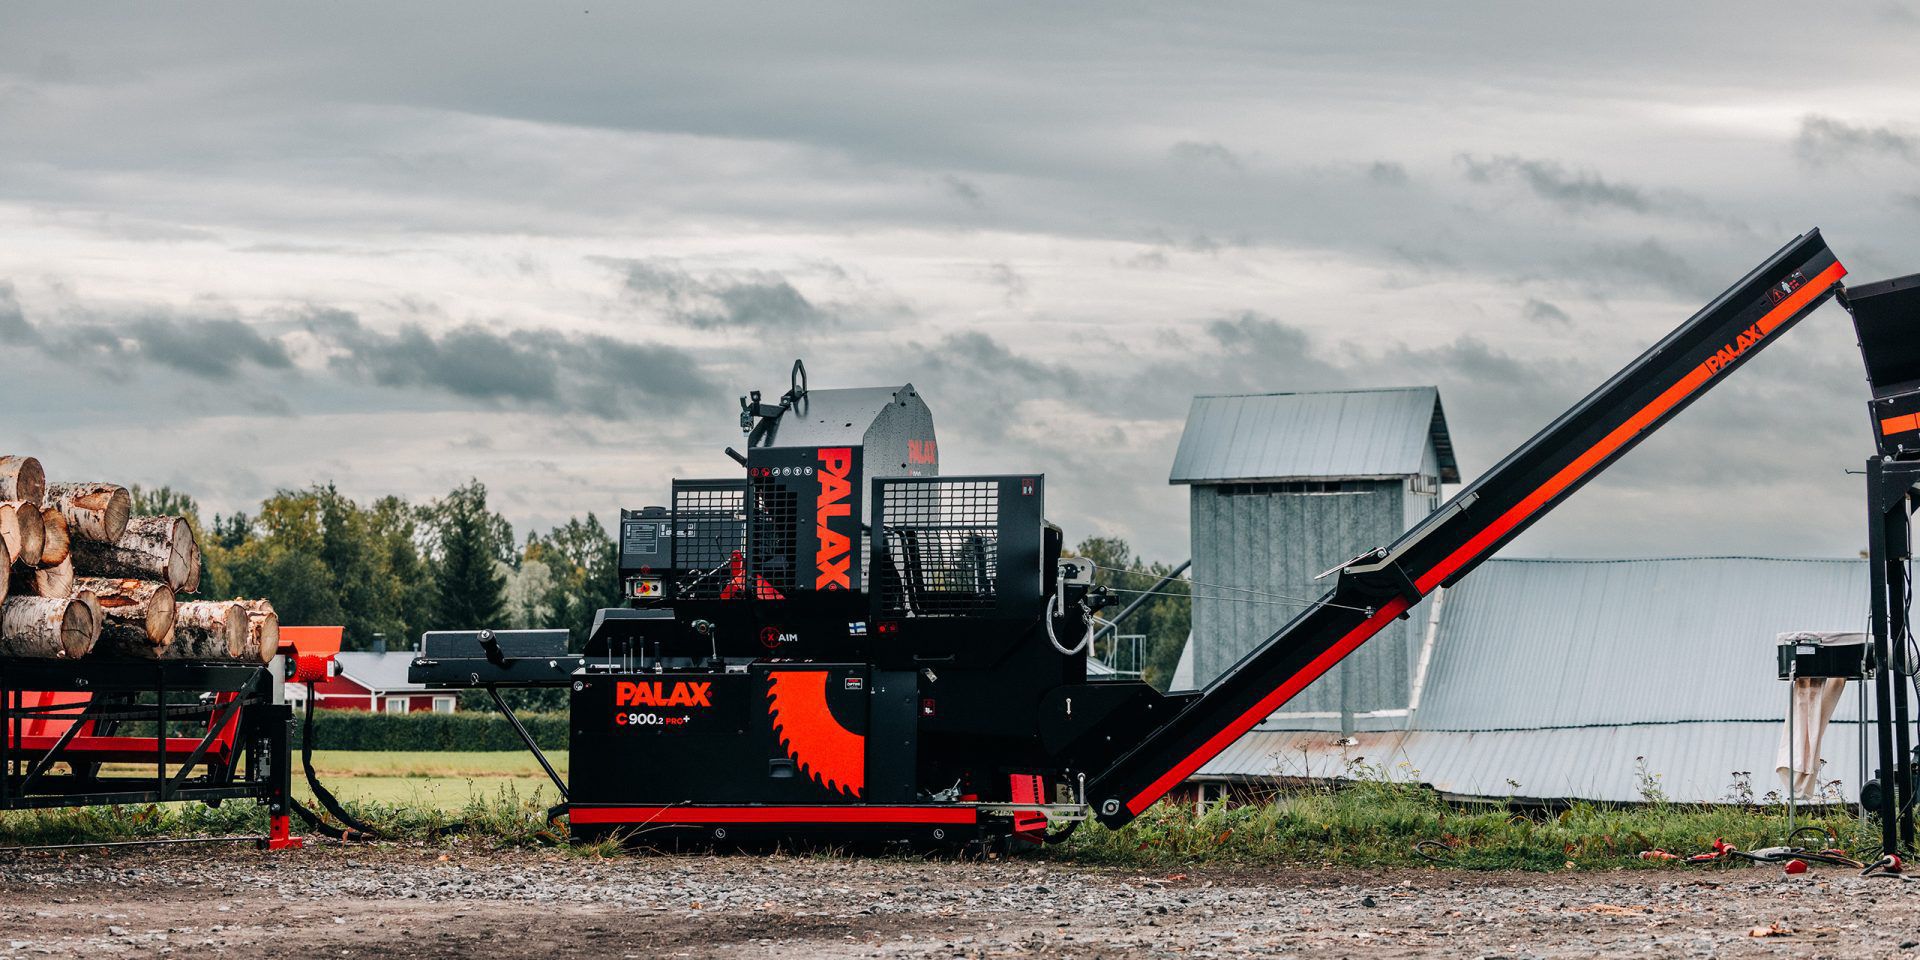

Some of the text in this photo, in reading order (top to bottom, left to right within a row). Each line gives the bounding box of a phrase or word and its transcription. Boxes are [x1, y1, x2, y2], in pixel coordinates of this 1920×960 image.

[1704, 323, 1764, 375] PALAX
[907, 439, 935, 464] PALAX
[815, 447, 852, 592] PALAX
[778, 633, 798, 642] AIM
[616, 681, 713, 707] PALAX
